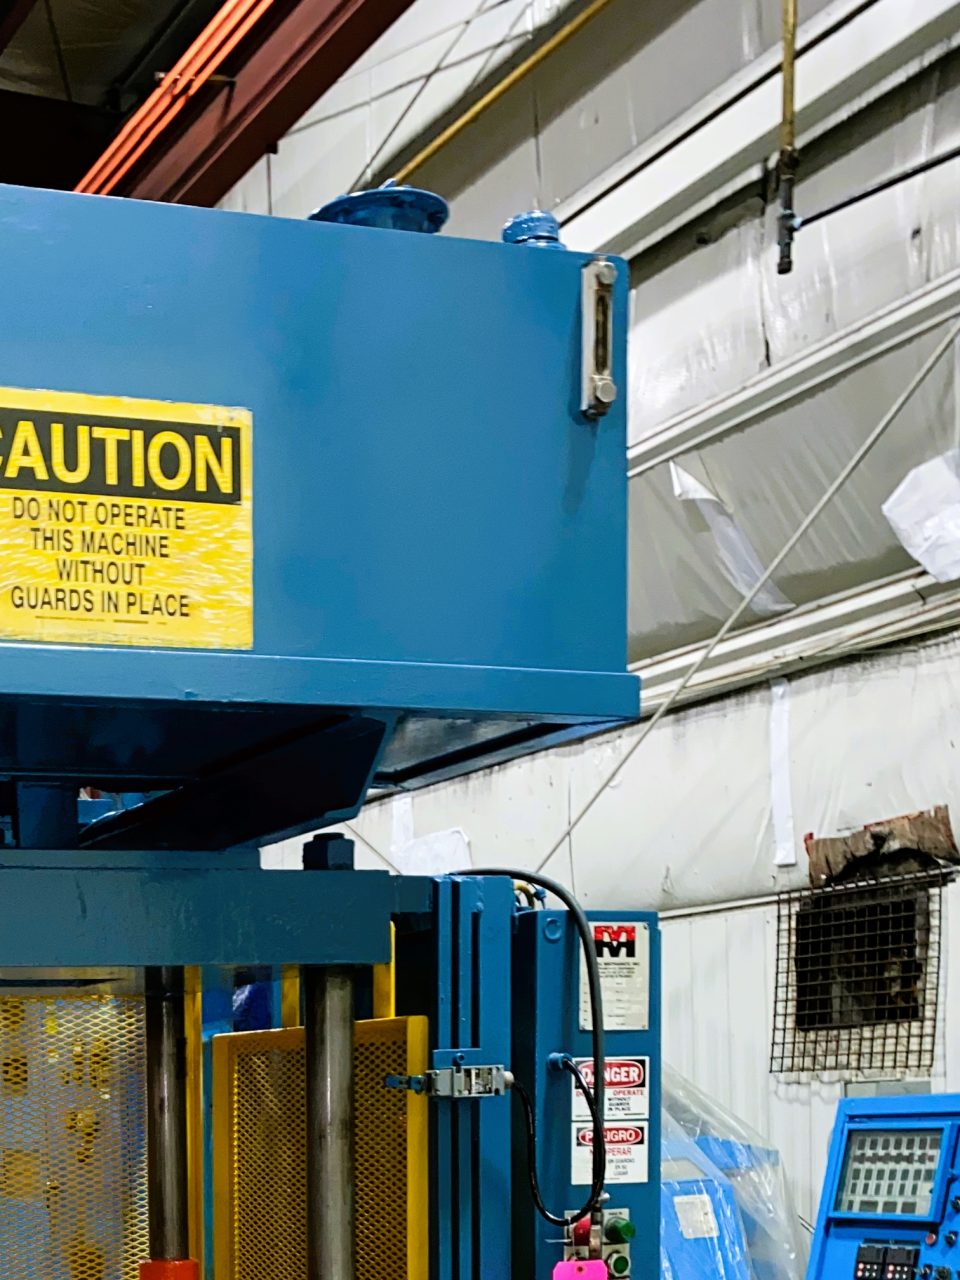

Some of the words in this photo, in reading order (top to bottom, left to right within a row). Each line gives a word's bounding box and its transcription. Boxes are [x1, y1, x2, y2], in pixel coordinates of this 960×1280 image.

[12, 496, 40, 520] DO
[48, 499, 87, 523] NOT
[95, 502, 186, 530] OPERATE
[30, 528, 73, 553] THIS
[81, 531, 170, 558] MACHINE
[56, 559, 146, 586] WITHOUT
[11, 586, 94, 613] GUARDS
[101, 591, 119, 613] IN
[126, 592, 191, 617] PLACE
[581, 1066, 640, 1083] DNGER
[585, 1129, 636, 1142] PIGRO
